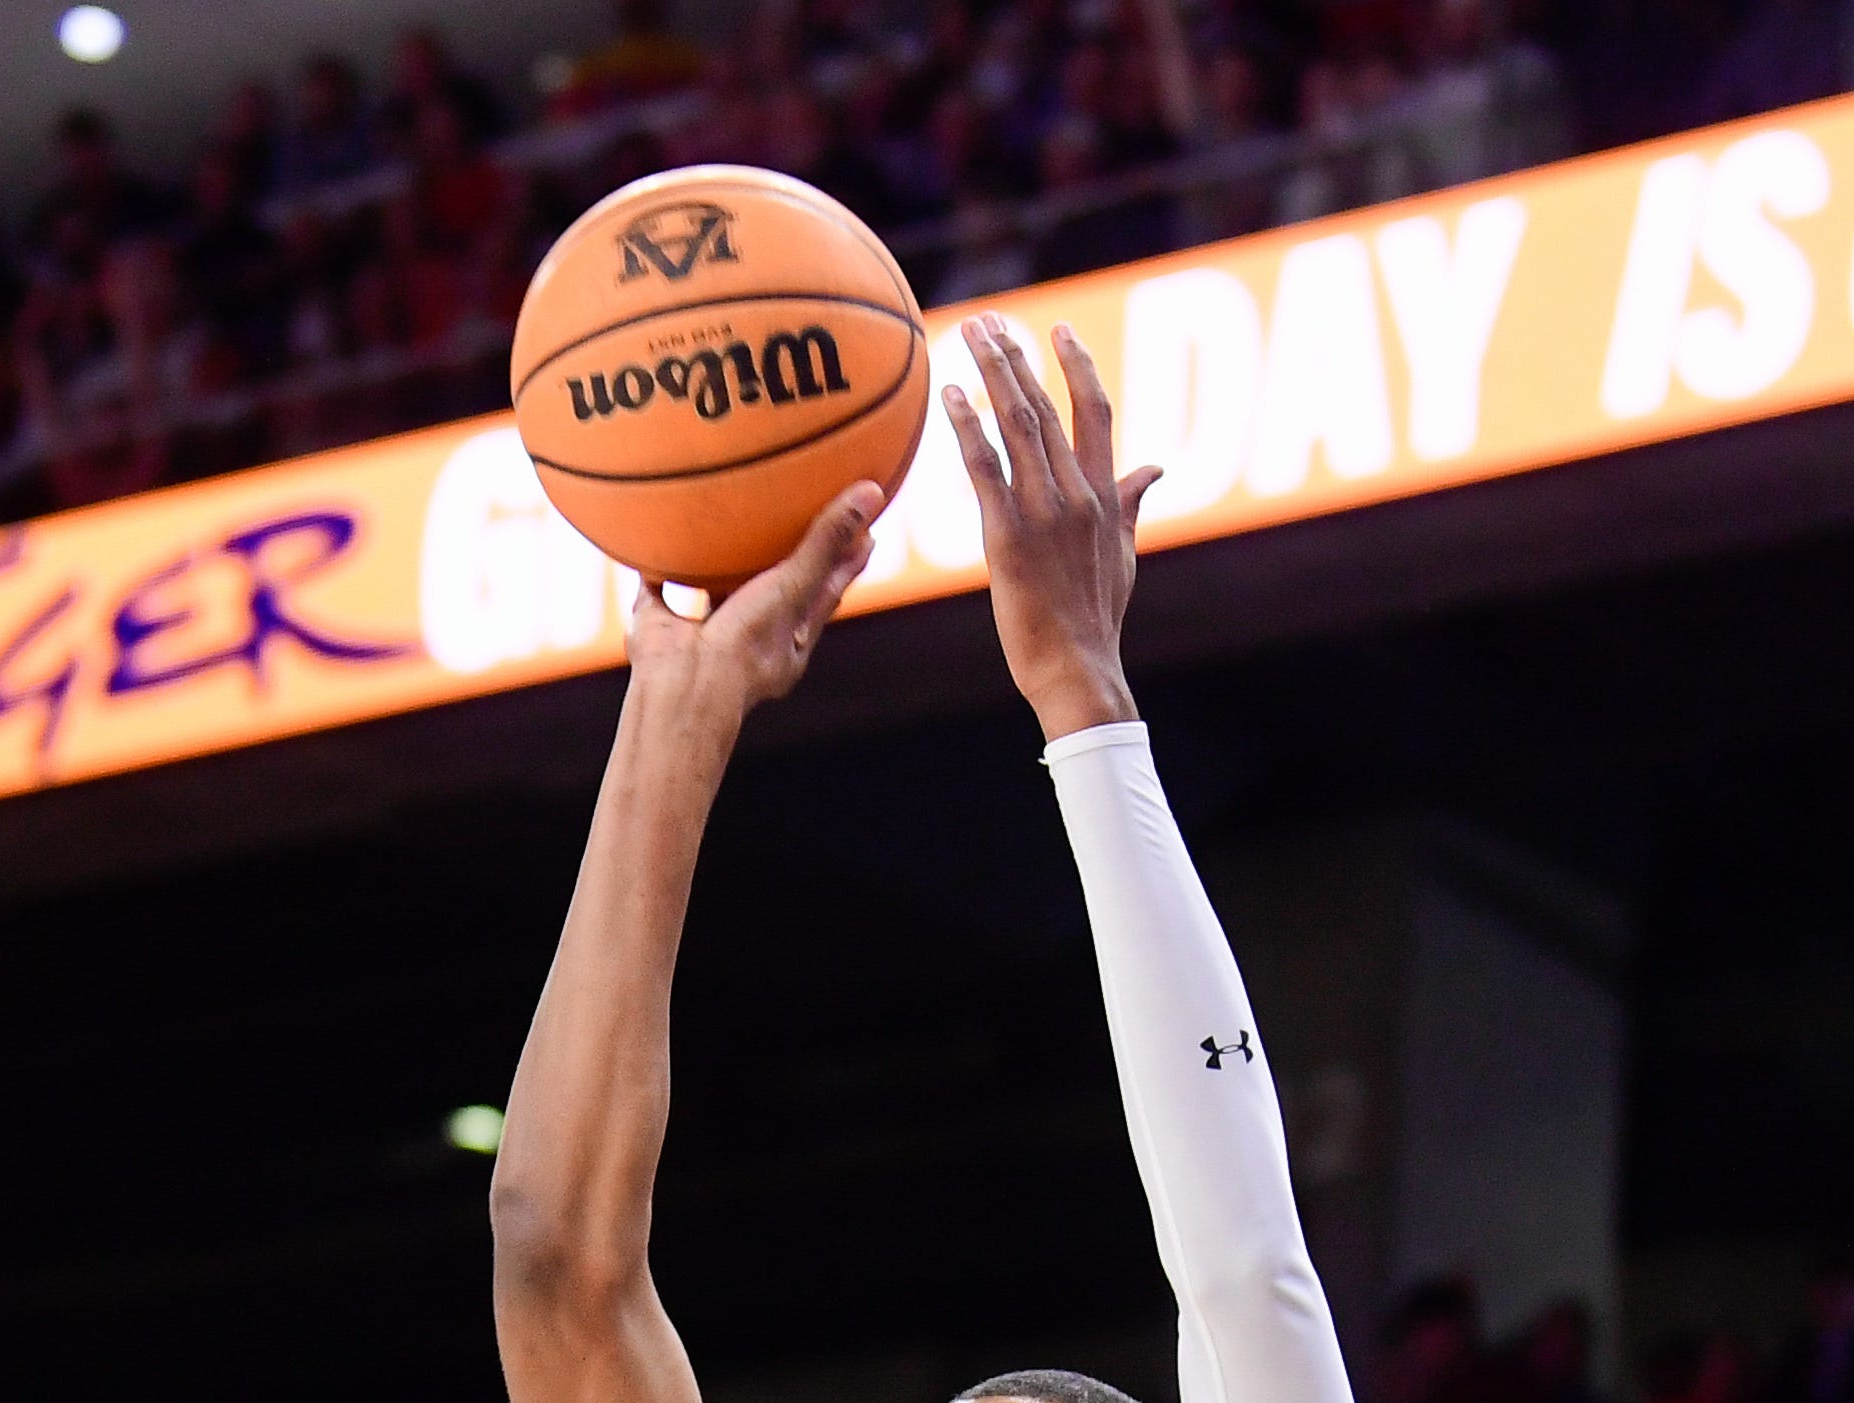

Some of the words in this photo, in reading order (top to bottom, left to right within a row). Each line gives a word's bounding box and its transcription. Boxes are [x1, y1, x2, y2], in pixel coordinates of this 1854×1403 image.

[566, 324, 850, 421] Wilson
[1112, 196, 1530, 526] DAY
[1599, 128, 1832, 421] IS
